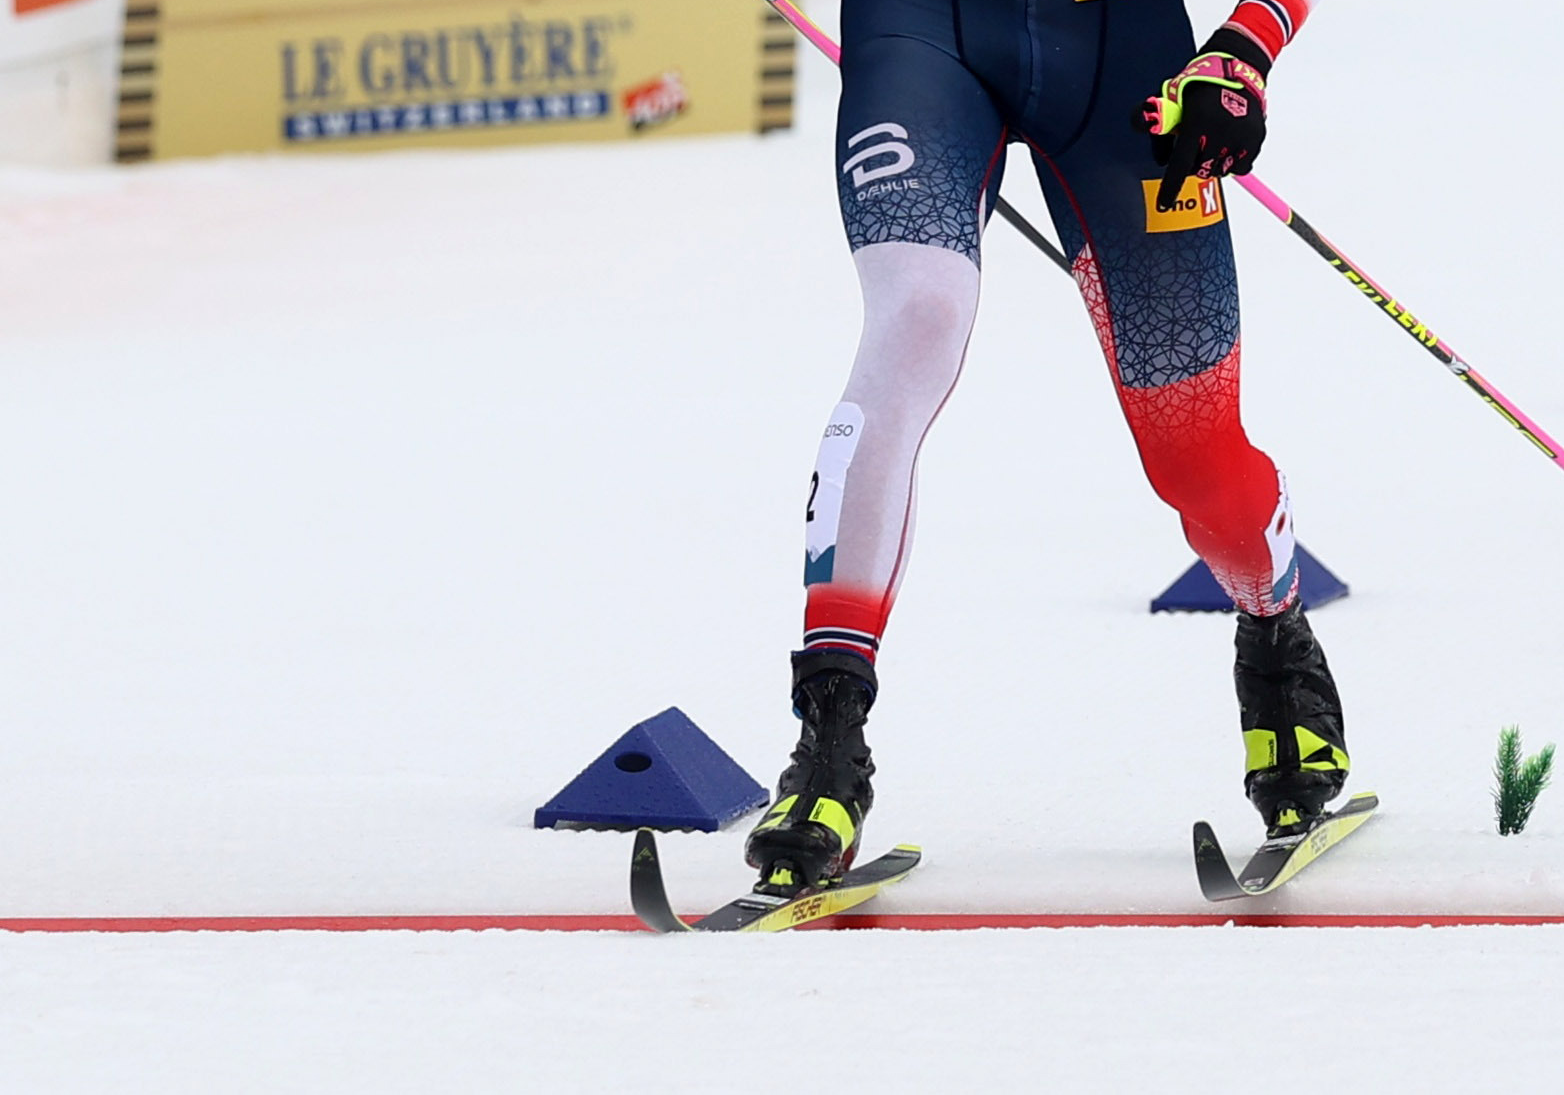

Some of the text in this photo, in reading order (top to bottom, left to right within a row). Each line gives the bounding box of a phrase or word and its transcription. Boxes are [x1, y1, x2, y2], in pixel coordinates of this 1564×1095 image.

[281, 9, 616, 104] LE GRUYÈRE
[1384, 299, 1439, 348] LEKI
[806, 471, 819, 523] 2
